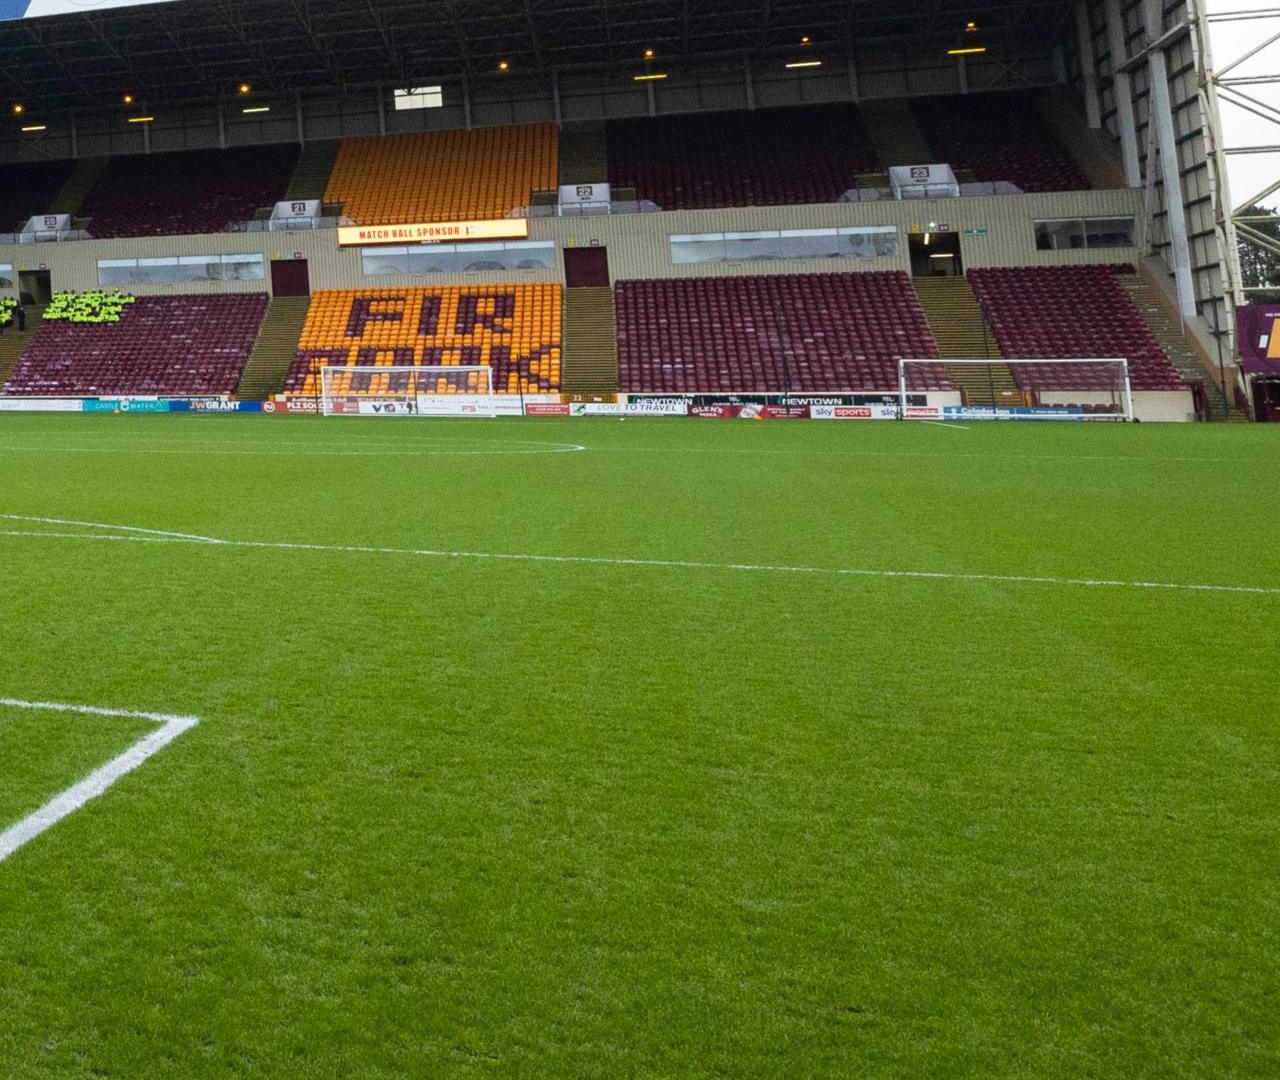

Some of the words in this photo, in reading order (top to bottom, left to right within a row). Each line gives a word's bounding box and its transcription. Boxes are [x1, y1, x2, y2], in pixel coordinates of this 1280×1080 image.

[912, 168, 928, 177] 23
[359, 229, 389, 240] MATCH
[392, 228, 413, 239] BALL
[416, 227, 460, 238] SPONSOR
[346, 294, 514, 337] FIR
[816, 407, 833, 417] sky
[835, 409, 870, 417] sports
